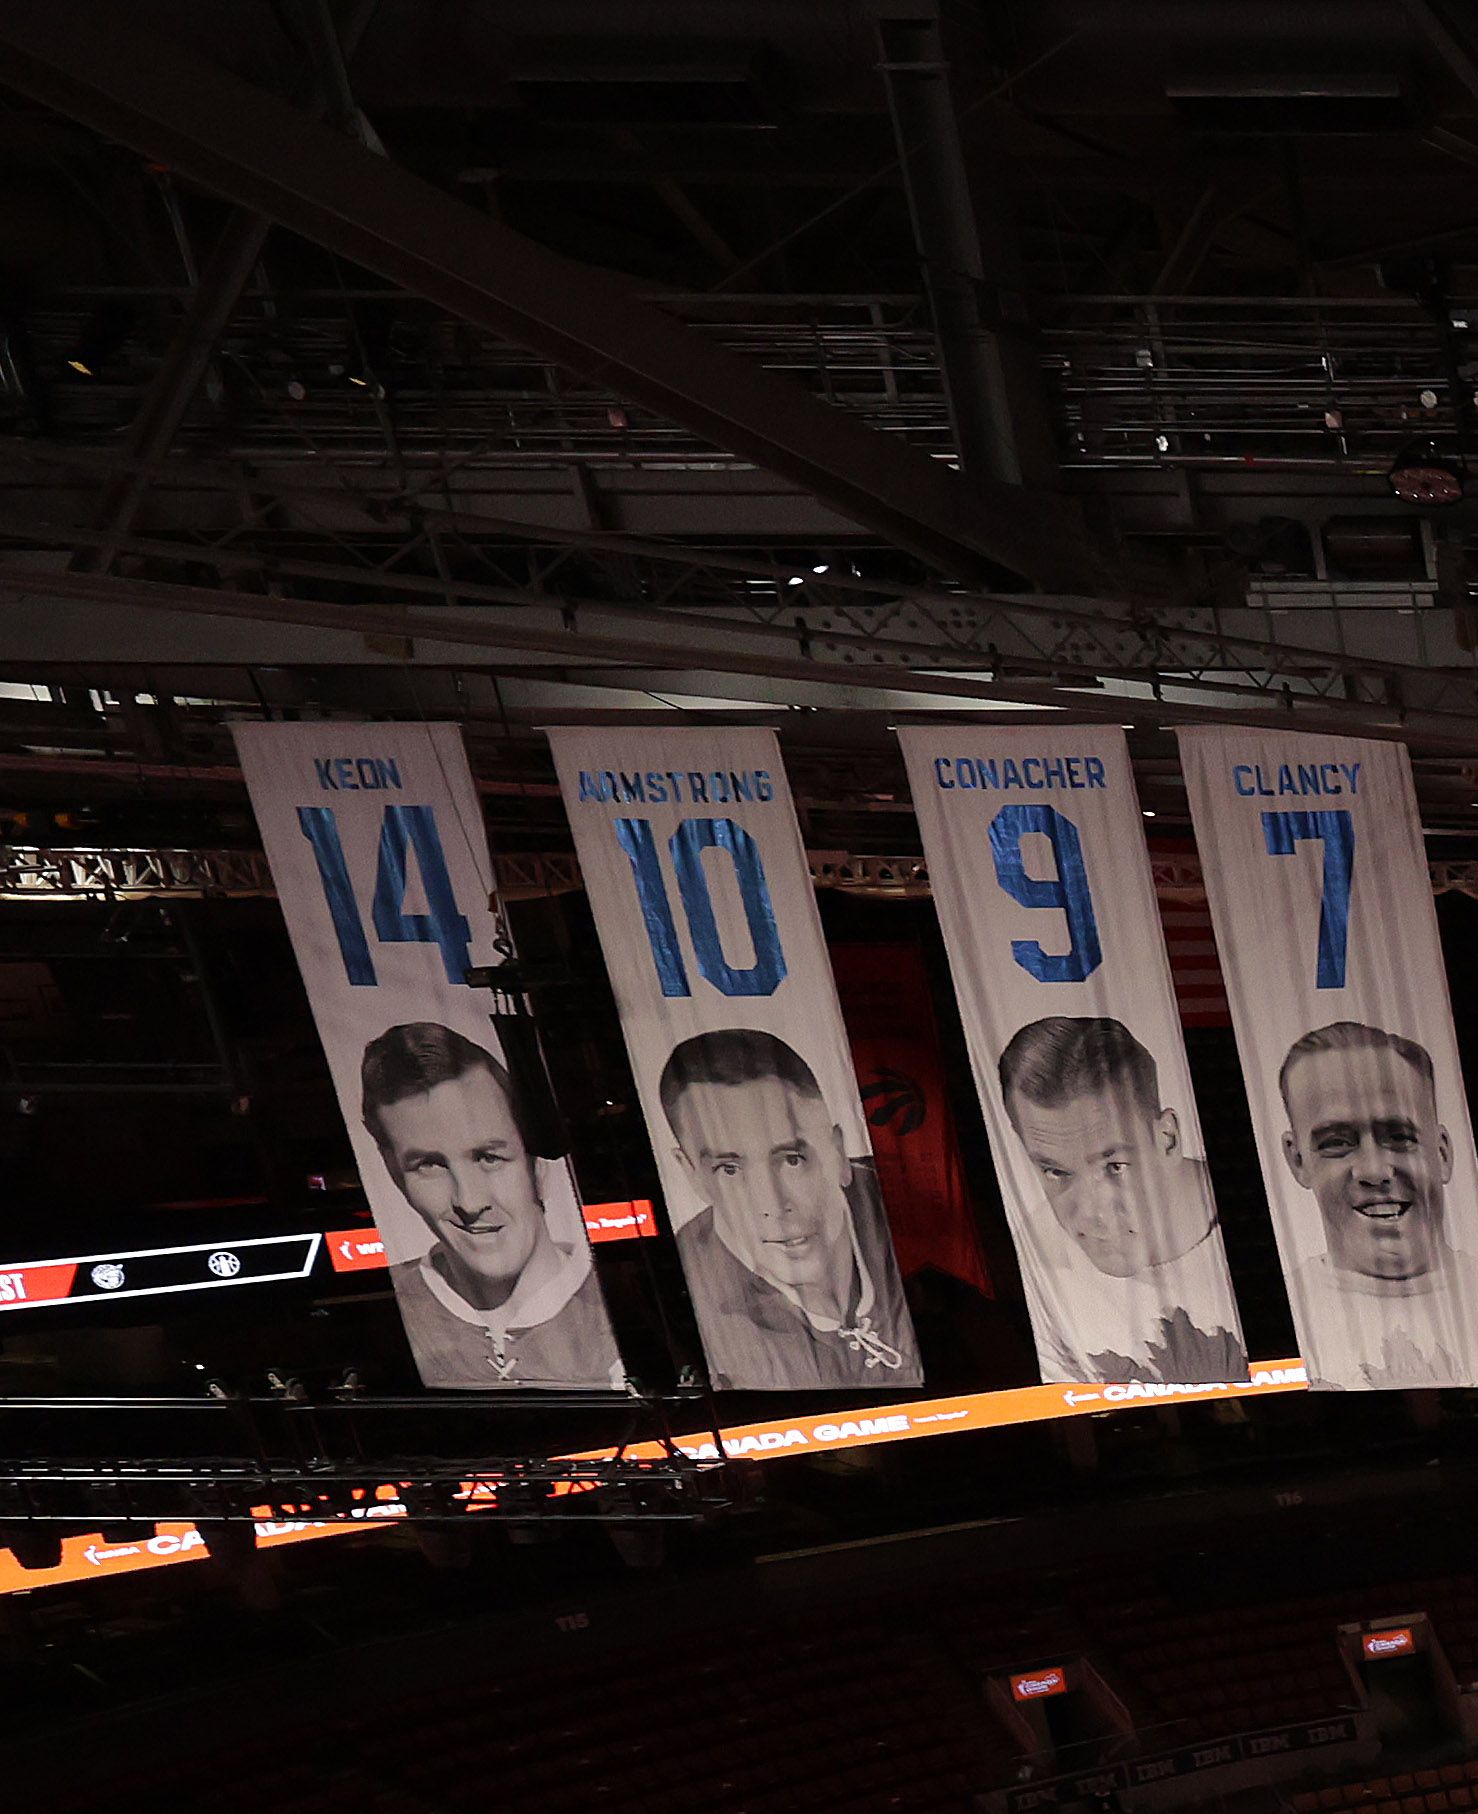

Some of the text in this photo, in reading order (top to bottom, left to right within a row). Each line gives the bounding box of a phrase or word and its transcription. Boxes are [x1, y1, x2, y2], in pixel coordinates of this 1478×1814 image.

[314, 757, 402, 791] KEON
[577, 770, 775, 803] ARMSTRONG
[934, 756, 1106, 790] CONACHER
[1233, 762, 1361, 796] CLANCY
[296, 805, 471, 986] 14
[612, 816, 788, 997] 10
[987, 804, 1103, 982] 9
[1261, 810, 1355, 989] 7
[814, 1415, 910, 1442] GAME
